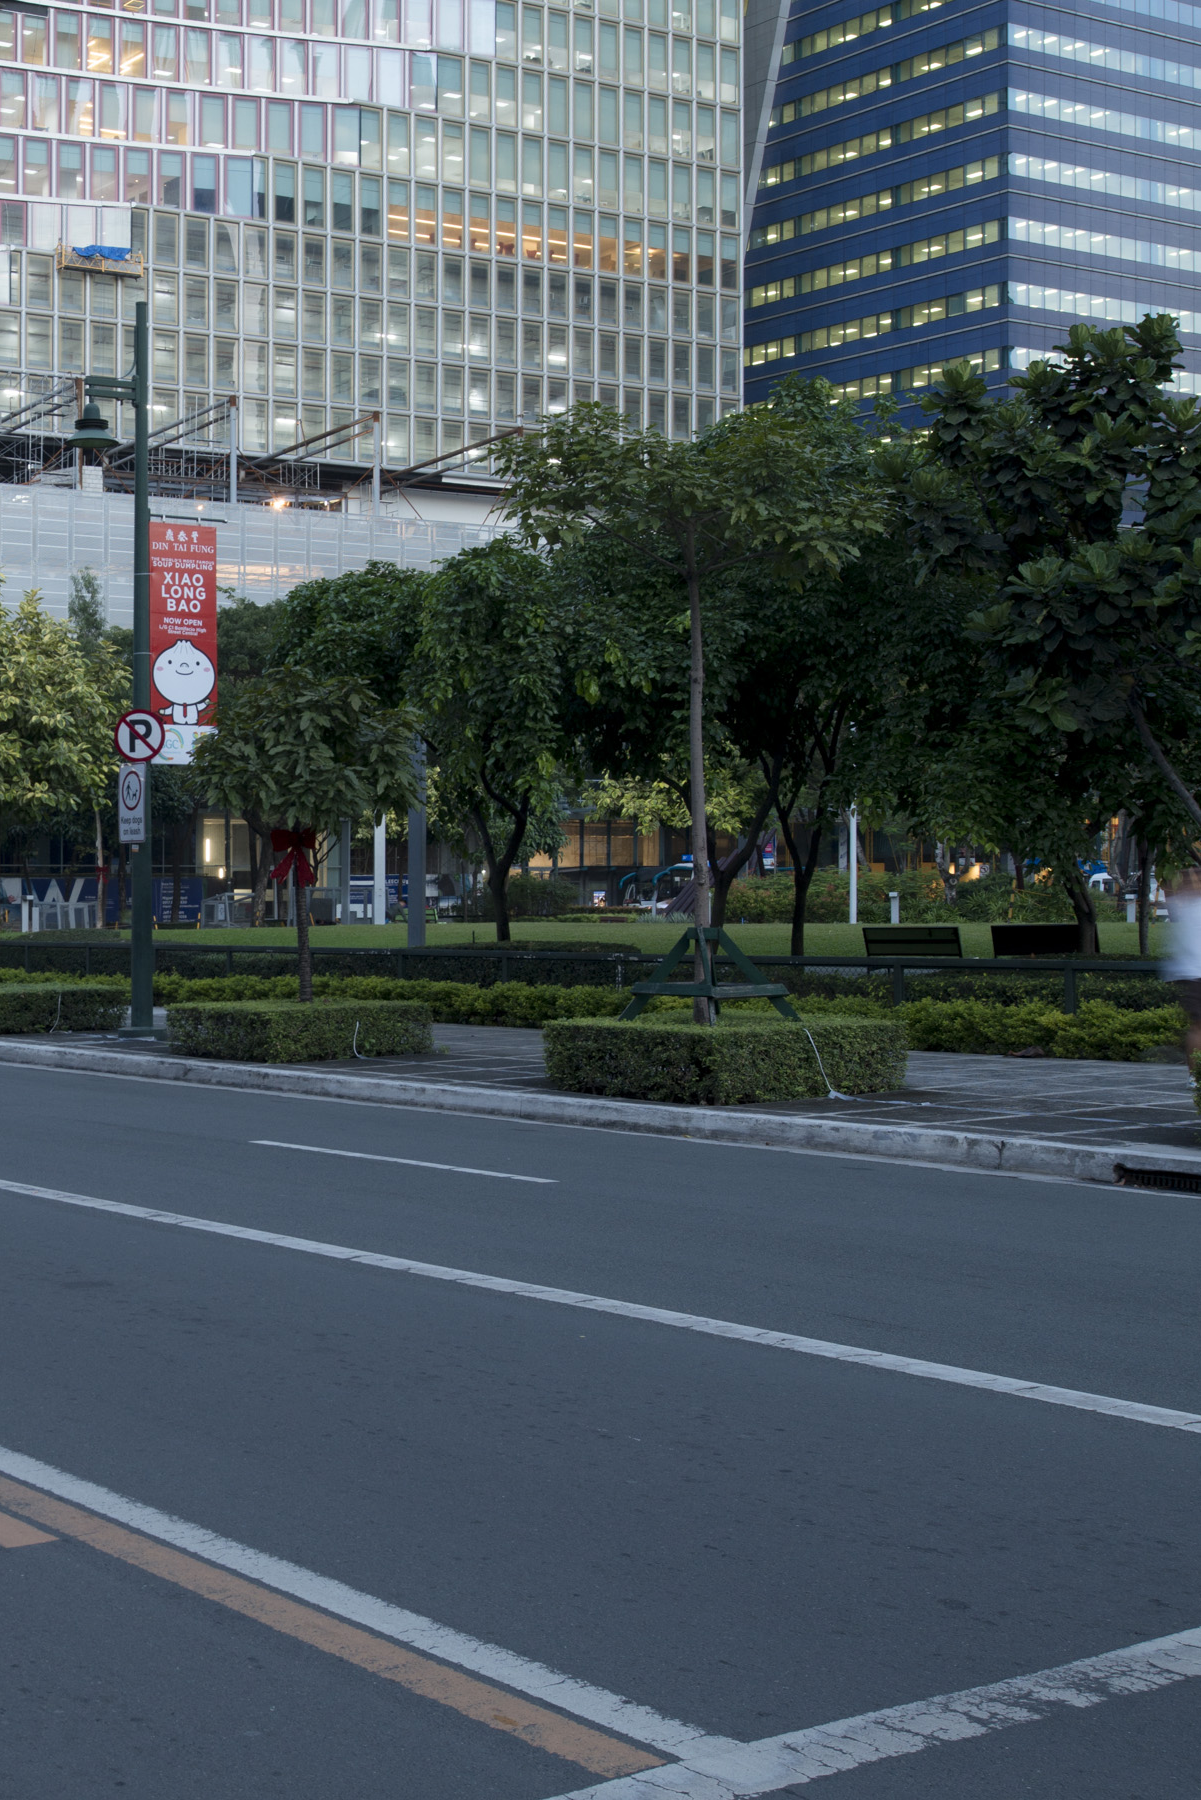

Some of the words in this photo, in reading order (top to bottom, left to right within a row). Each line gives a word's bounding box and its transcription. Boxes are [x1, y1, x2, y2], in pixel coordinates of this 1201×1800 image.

[152, 541, 169, 551] DIN
[173, 543, 187, 552] TAI
[190, 544, 214, 554] FUNG
[152, 560, 173, 568] SOUP
[175, 561, 213, 571] DUMPLING
[163, 571, 204, 587] XIAO
[161, 585, 206, 600] LONG
[167, 598, 201, 613] BAO
[163, 617, 182, 625] NOW
[183, 618, 203, 627] OPEN
[129, 719, 152, 753] P
[163, 738, 179, 749] GC
[121, 816, 131, 825] Keep
[132, 816, 142, 825] dogs
